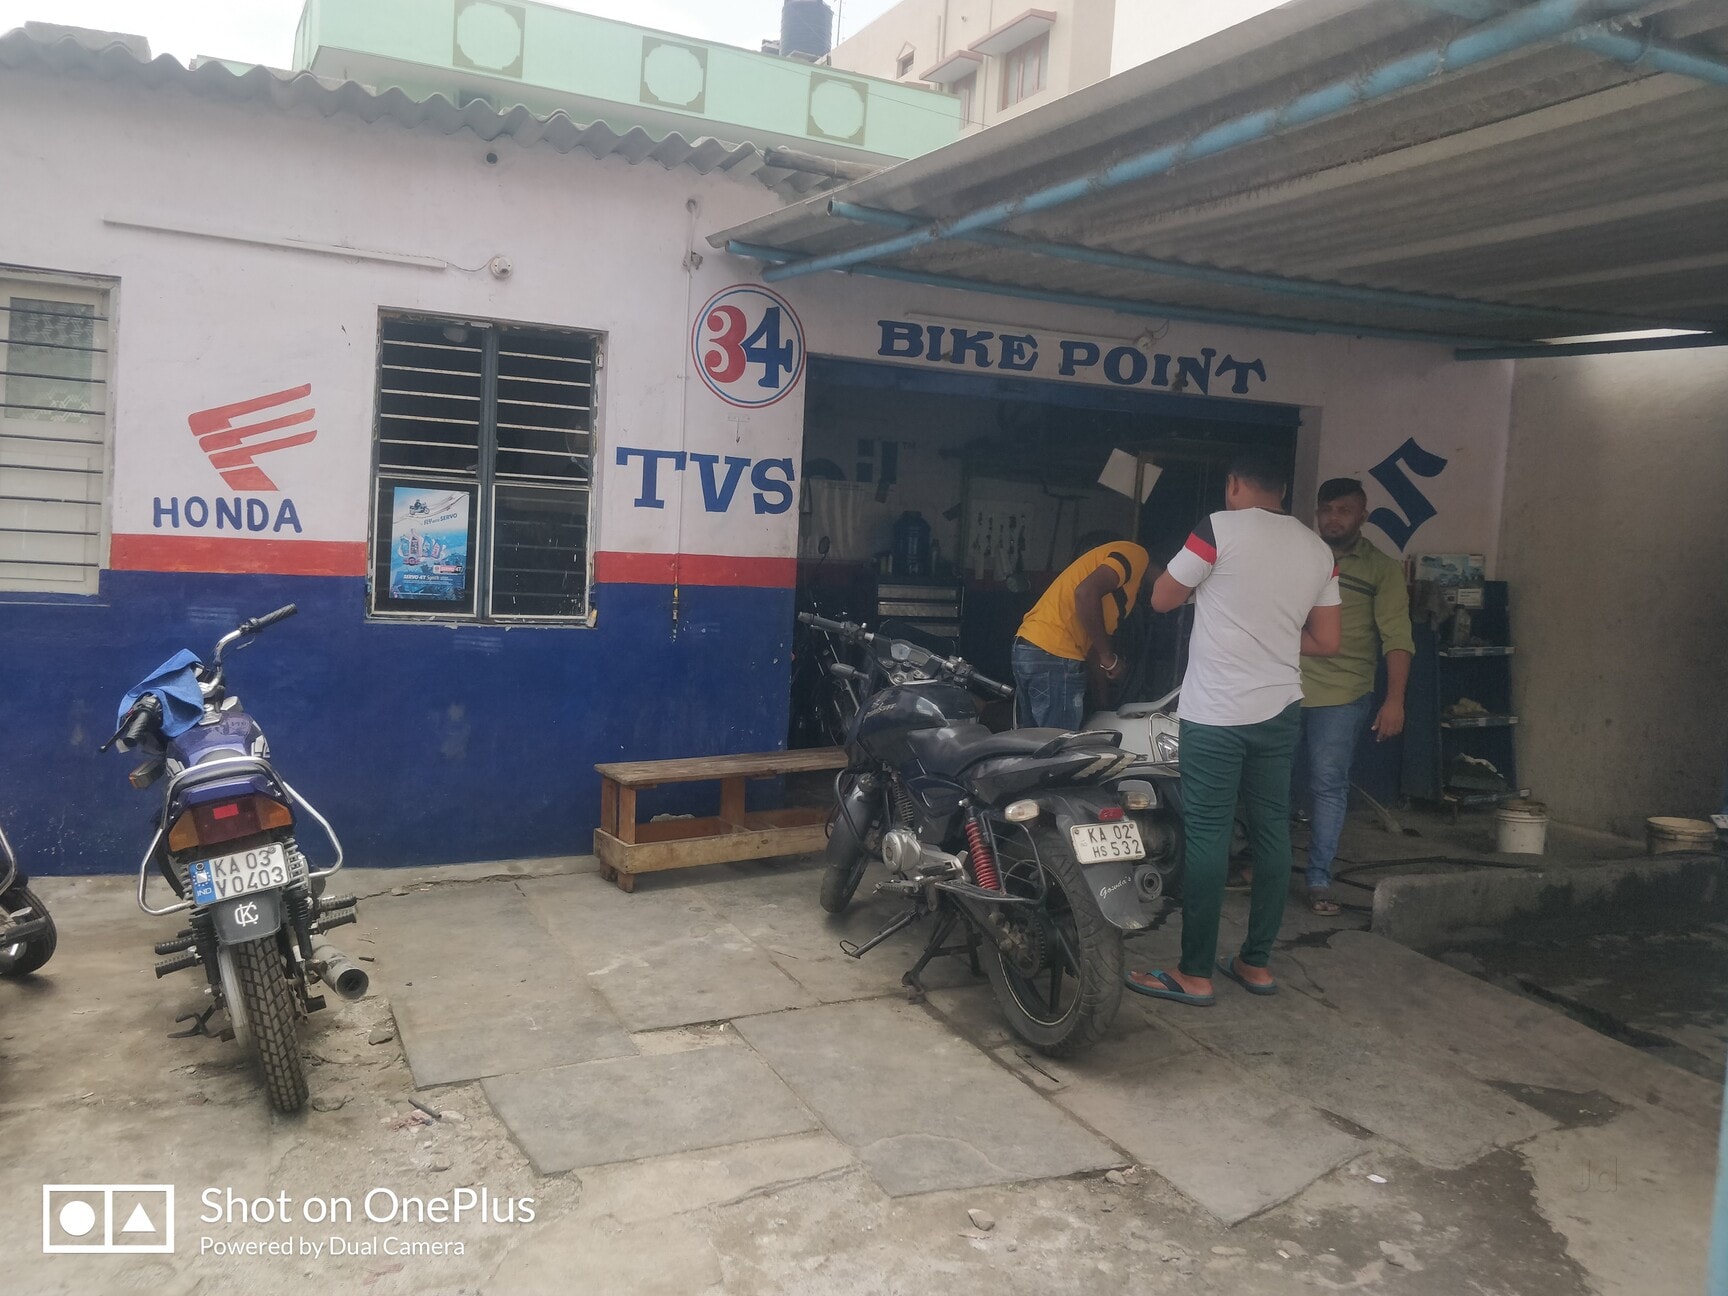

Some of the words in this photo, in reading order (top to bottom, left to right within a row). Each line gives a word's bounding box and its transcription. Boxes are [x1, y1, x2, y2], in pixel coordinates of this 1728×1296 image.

[704, 305, 793, 388] 34
[877, 319, 1039, 371] BIKE
[1058, 339, 1267, 396] POINT
[616, 446, 795, 515] TVS
[153, 495, 302, 533] HONDA
[440, 512, 458, 522] SERVO
[1087, 826, 1107, 843] KA
[1113, 824, 1132, 840] 02
[214, 856, 241, 877] KA
[245, 849, 271, 869] 03
[196, 887, 213, 897] IND
